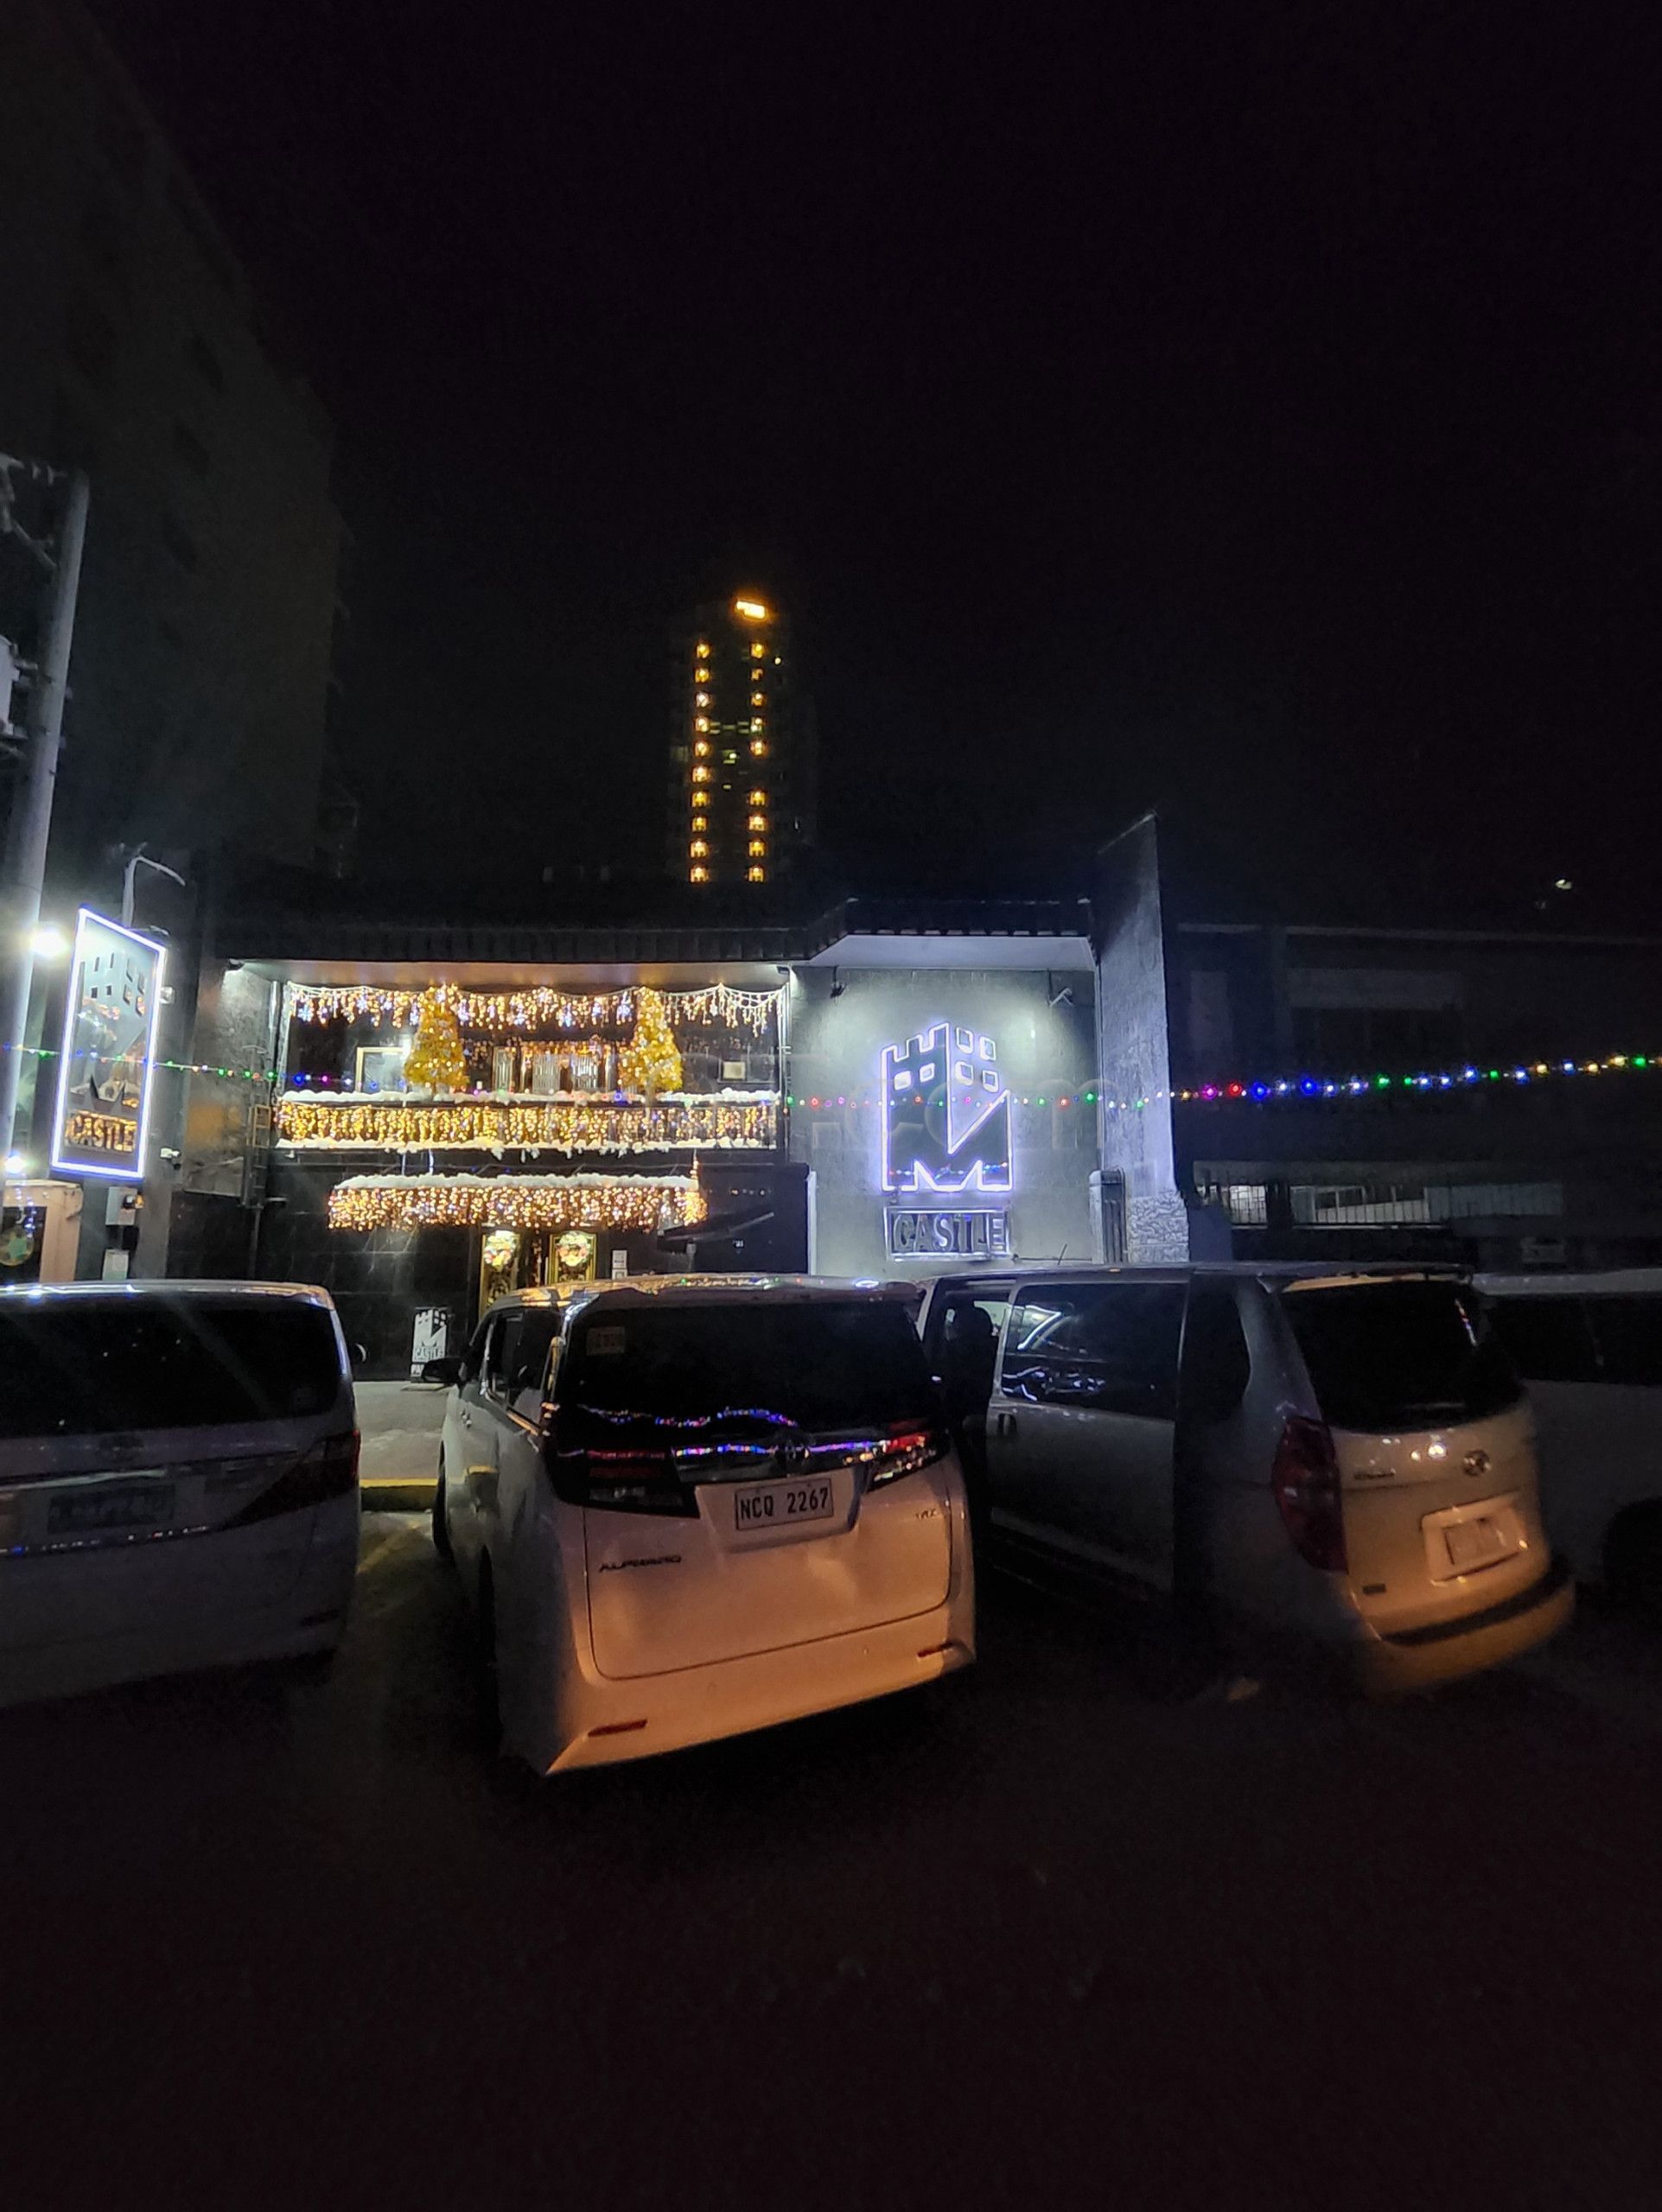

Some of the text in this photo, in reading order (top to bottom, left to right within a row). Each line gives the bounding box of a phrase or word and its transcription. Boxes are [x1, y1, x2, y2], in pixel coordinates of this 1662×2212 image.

[65, 1115, 135, 1152] CASTLE
[893, 1213, 1005, 1254] CASTLE
[740, 1487, 828, 1520] NCQ 2267
